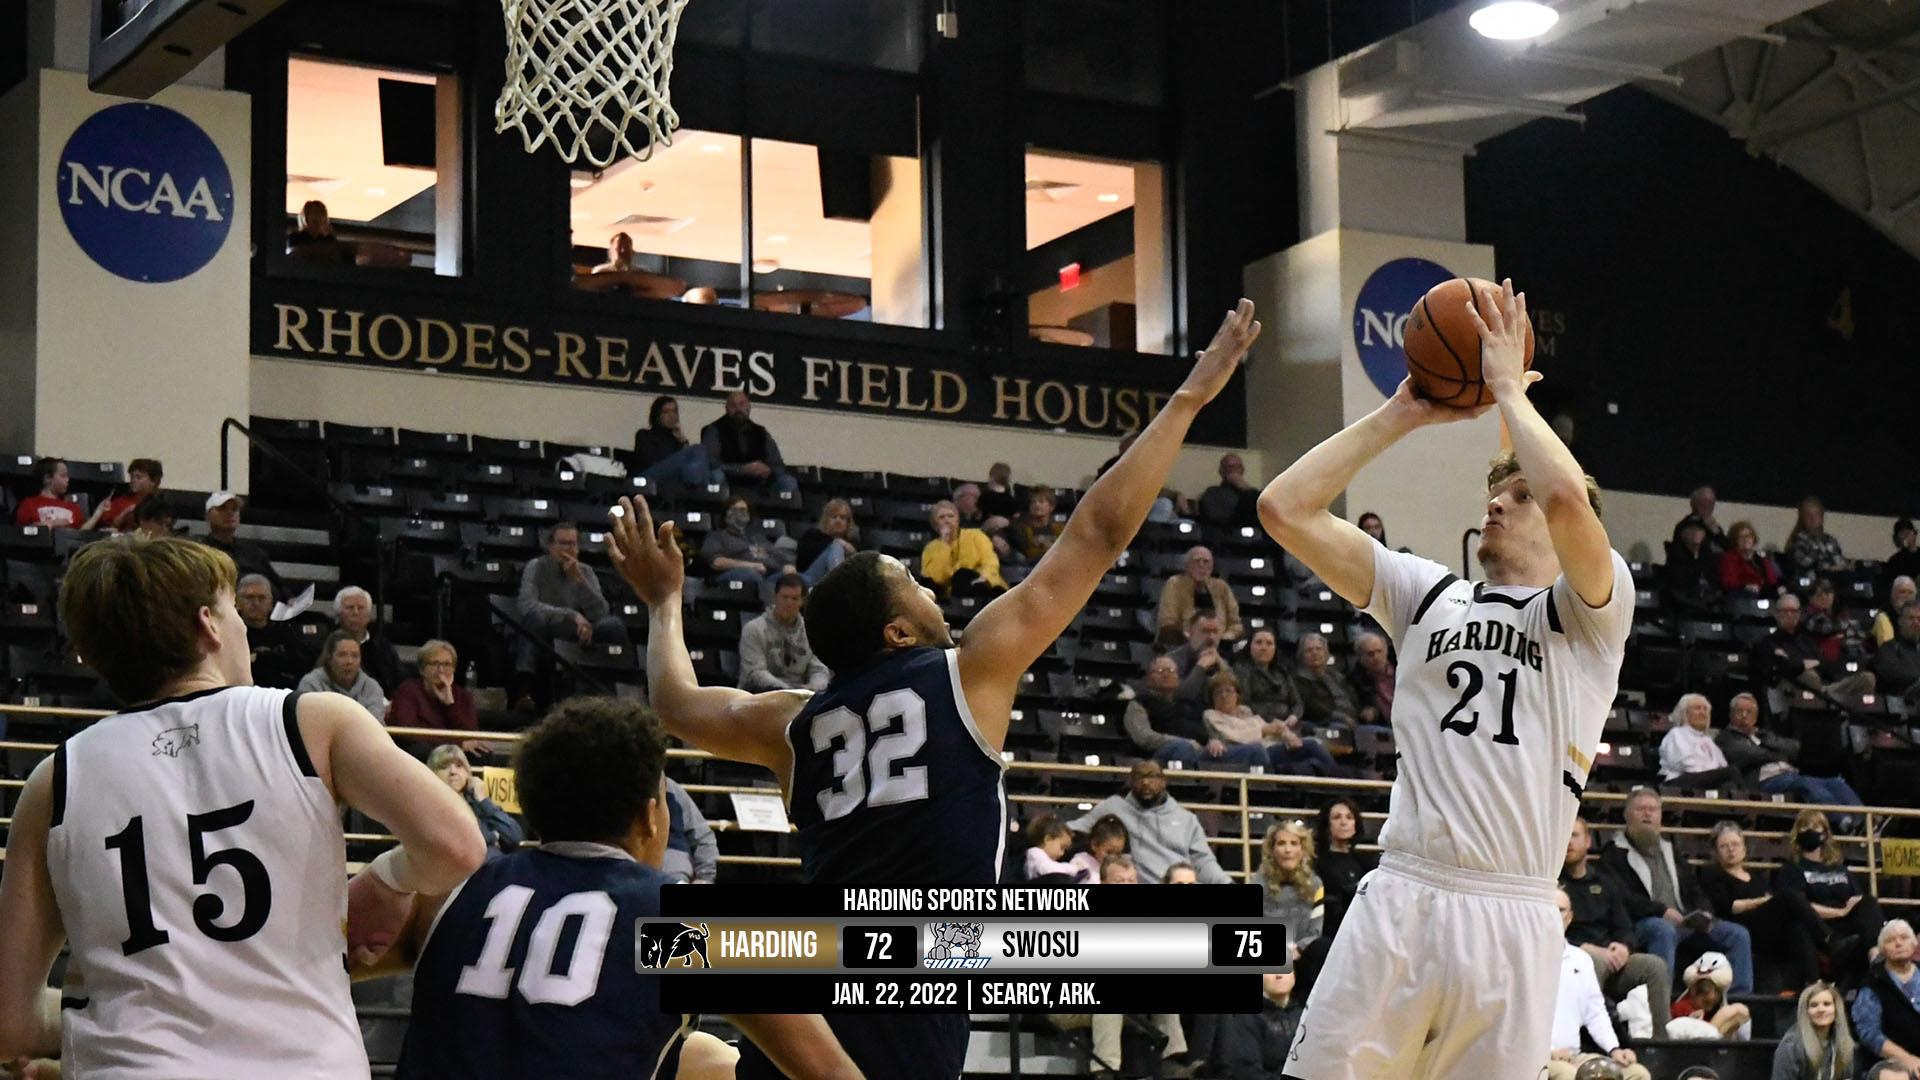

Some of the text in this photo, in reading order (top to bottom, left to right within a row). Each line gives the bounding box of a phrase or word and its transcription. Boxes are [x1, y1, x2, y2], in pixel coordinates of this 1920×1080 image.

[66, 162, 224, 221] NCAA
[273, 303, 777, 397] RHODES-REAVES
[801, 356, 968, 415] FIELD
[1425, 620, 1543, 673] HARDING
[810, 687, 929, 822] 32
[1440, 660, 1520, 746] 21
[105, 799, 272, 957] 15
[455, 884, 618, 1007] 10
